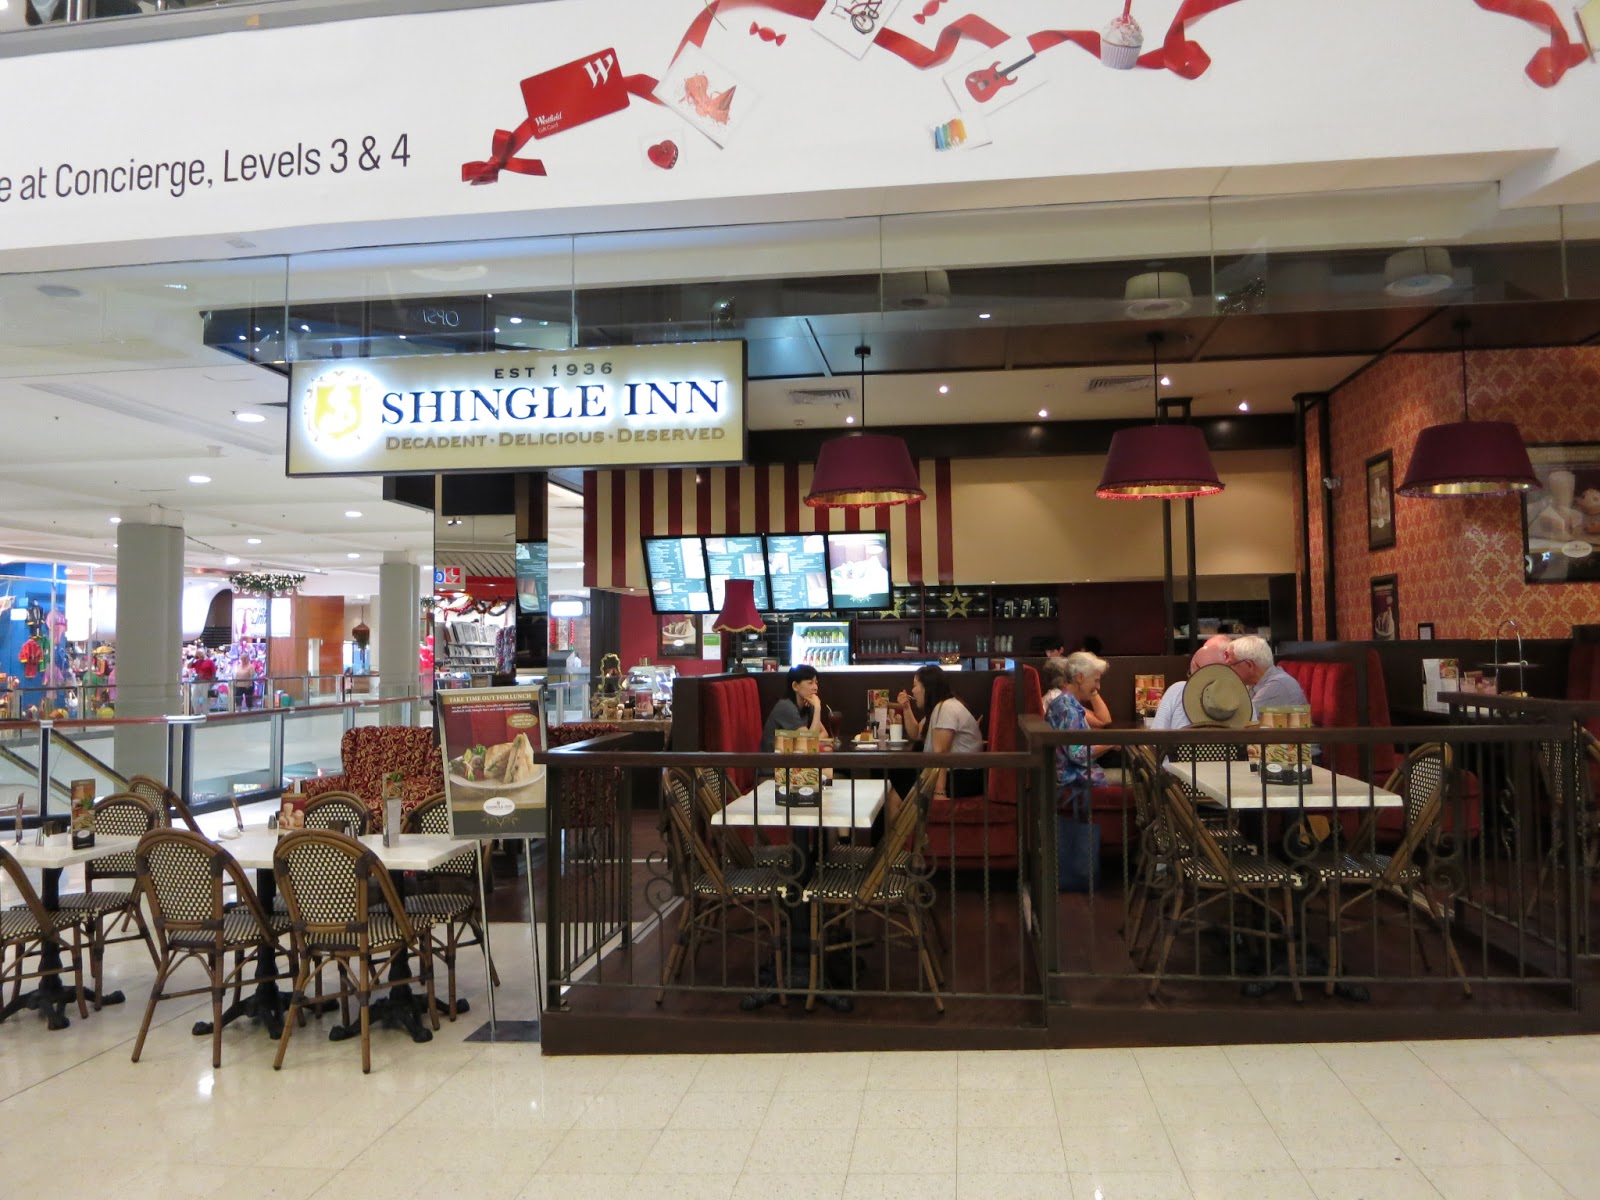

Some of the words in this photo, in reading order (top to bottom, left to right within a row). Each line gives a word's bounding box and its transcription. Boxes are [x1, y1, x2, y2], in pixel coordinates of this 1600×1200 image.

[535, 112, 562, 127] Westfield
[19, 166, 48, 201] at
[55, 158, 213, 198] Concierge,
[223, 142, 321, 182] Levels
[330, 138, 348, 173] 3
[358, 135, 381, 171] &
[391, 133, 411, 167] 4
[494, 367, 535, 379] EST
[551, 362, 613, 377] 1936
[381, 384, 607, 425] SHINGLE
[624, 379, 724, 417] INN
[385, 435, 488, 451] DECADENT
[498, 431, 605, 447] DELICIOUS
[617, 427, 725, 443] DESERVED
